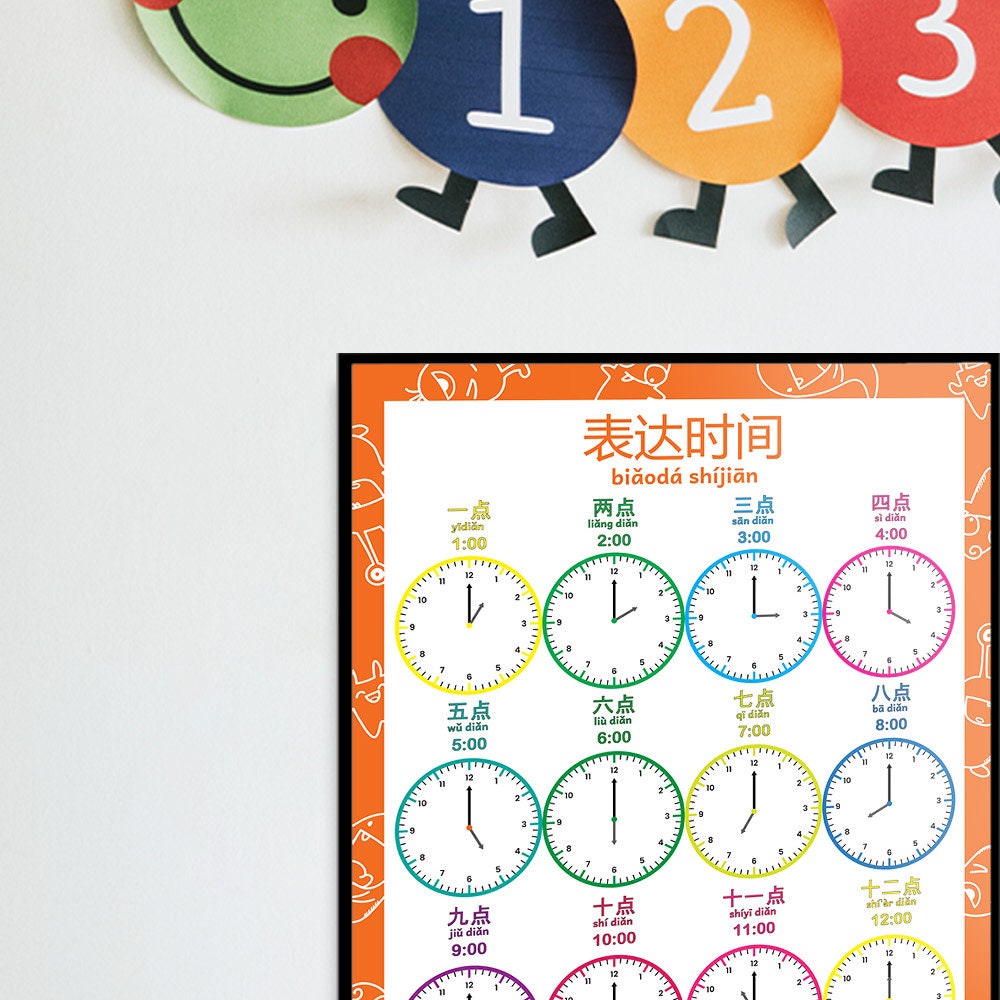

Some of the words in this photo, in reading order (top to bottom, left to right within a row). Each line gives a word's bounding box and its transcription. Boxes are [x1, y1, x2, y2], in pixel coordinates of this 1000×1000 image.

[897, 0, 978, 98] 3
[466, 0, 555, 135] 1
[665, 0, 773, 133] 2
[584, 413, 782, 462] 表达时间
[612, 467, 682, 485] biǎodá
[690, 467, 758, 488] shíjiān
[593, 497, 635, 517] 两点
[734, 495, 774, 514] 三点
[872, 493, 911, 512] 四点
[447, 500, 491, 520] 一点
[738, 531, 770, 543] 3:00
[875, 528, 907, 540] 4:00
[452, 537, 487, 550] 1:00
[598, 534, 631, 547] 2:00
[885, 560, 894, 568] 12
[912, 564, 916, 572] 1
[861, 566, 868, 574] 11
[464, 571, 474, 579] 12
[494, 575, 499, 583] 1
[438, 577, 446, 585] 11
[930, 581, 936, 589] 2
[842, 583, 852, 592] 10
[417, 596, 428, 604] 10
[514, 593, 521, 601] 2
[835, 609, 841, 617] 9
[936, 606, 942, 614] 3
[409, 623, 416, 632] 9
[521, 619, 527, 628] 3
[844, 634, 850, 643] 8
[930, 631, 936, 639] 4
[419, 650, 426, 658] 8
[514, 646, 521, 654] 4
[862, 650, 868, 658] 7
[912, 648, 918, 656] 5
[886, 656, 893, 664] 6
[439, 666, 446, 674] 7
[495, 663, 502, 672] 5
[466, 672, 473, 681] 6
[872, 683, 911, 702] 八点
[734, 688, 775, 708] 七点
[593, 694, 635, 715] 六点
[447, 700, 491, 720] 五点
[876, 718, 907, 731] 8:00
[738, 724, 771, 738] 7:00
[597, 731, 631, 744] 6:00
[452, 737, 487, 751] 5:00
[610, 766, 619, 774] 12
[638, 769, 643, 778] 1
[584, 772, 592, 781] 11
[658, 786, 664, 795] 2
[564, 791, 574, 800] 10
[664, 812, 671, 820] 3
[556, 818, 563, 826] 9
[657, 838, 664, 846] 4
[565, 844, 572, 853] 8
[585, 860, 591, 868] 7
[639, 856, 646, 865] 5
[611, 865, 618, 874] 6
[861, 876, 921, 898] 十二点
[723, 885, 785, 907] 十一点
[593, 896, 635, 916] 十点
[448, 905, 491, 926] 九点
[871, 912, 912, 926] 12:00
[733, 922, 775, 936] 11:00
[593, 931, 636, 946] 10:00
[452, 942, 487, 956] 9:00
[749, 959, 759, 967] 12
[777, 962, 782, 970] 1
[725, 966, 732, 974] 11
[796, 978, 802, 986] 2
[705, 985, 715, 993] 10
